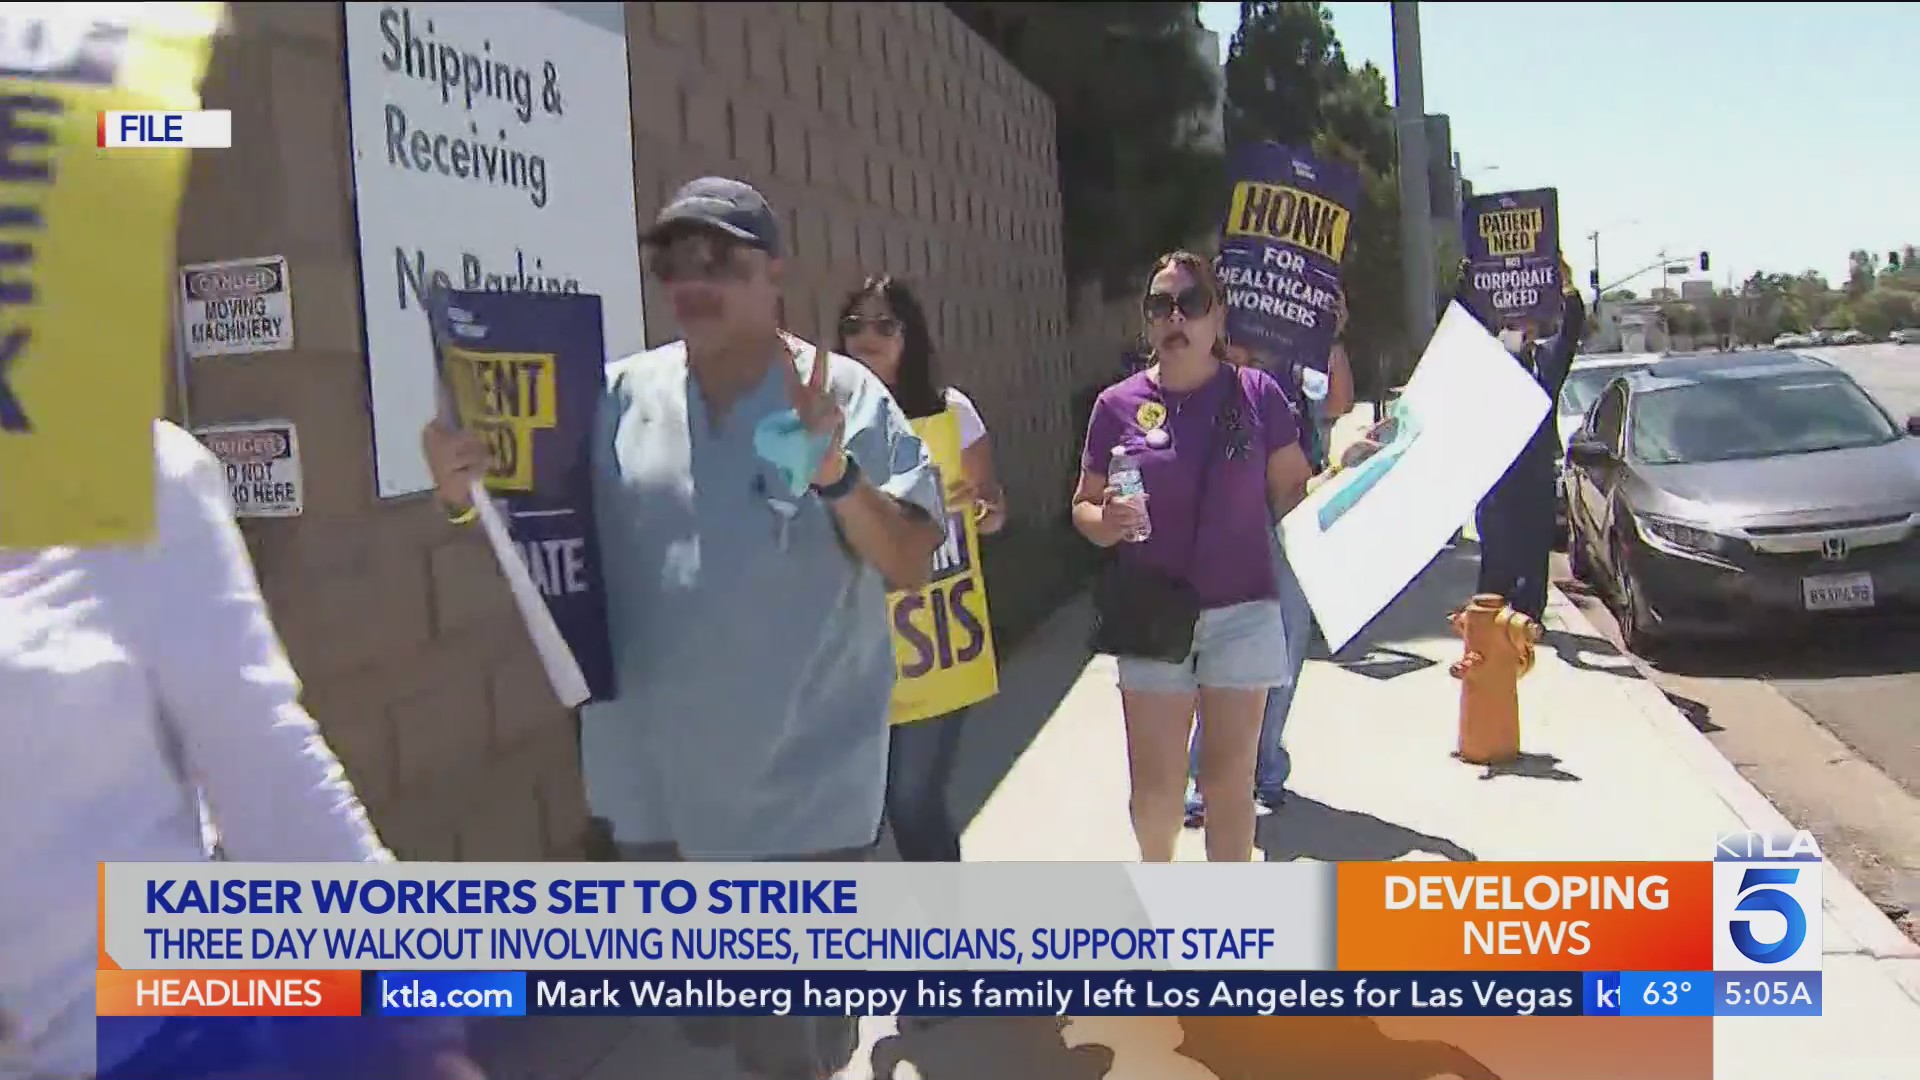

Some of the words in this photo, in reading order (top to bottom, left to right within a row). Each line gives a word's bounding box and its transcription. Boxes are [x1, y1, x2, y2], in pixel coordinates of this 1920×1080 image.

[379, 7, 532, 123] Shipping
[542, 59, 563, 115] &
[384, 103, 547, 209] Receiving
[1240, 184, 1341, 255] HONK
[1482, 210, 1537, 236] PATIENT
[1493, 231, 1530, 252] NEED
[1263, 246, 1306, 273] FOR
[1474, 265, 1553, 290] CORPORATE
[205, 297, 266, 321] MOVING
[1226, 288, 1318, 329] WORKERS
[1492, 288, 1538, 309] GREED
[191, 317, 282, 343] MACHINERY
[241, 460, 273, 483] NOT
[253, 481, 297, 503] HERE
[893, 578, 984, 679] SIS
